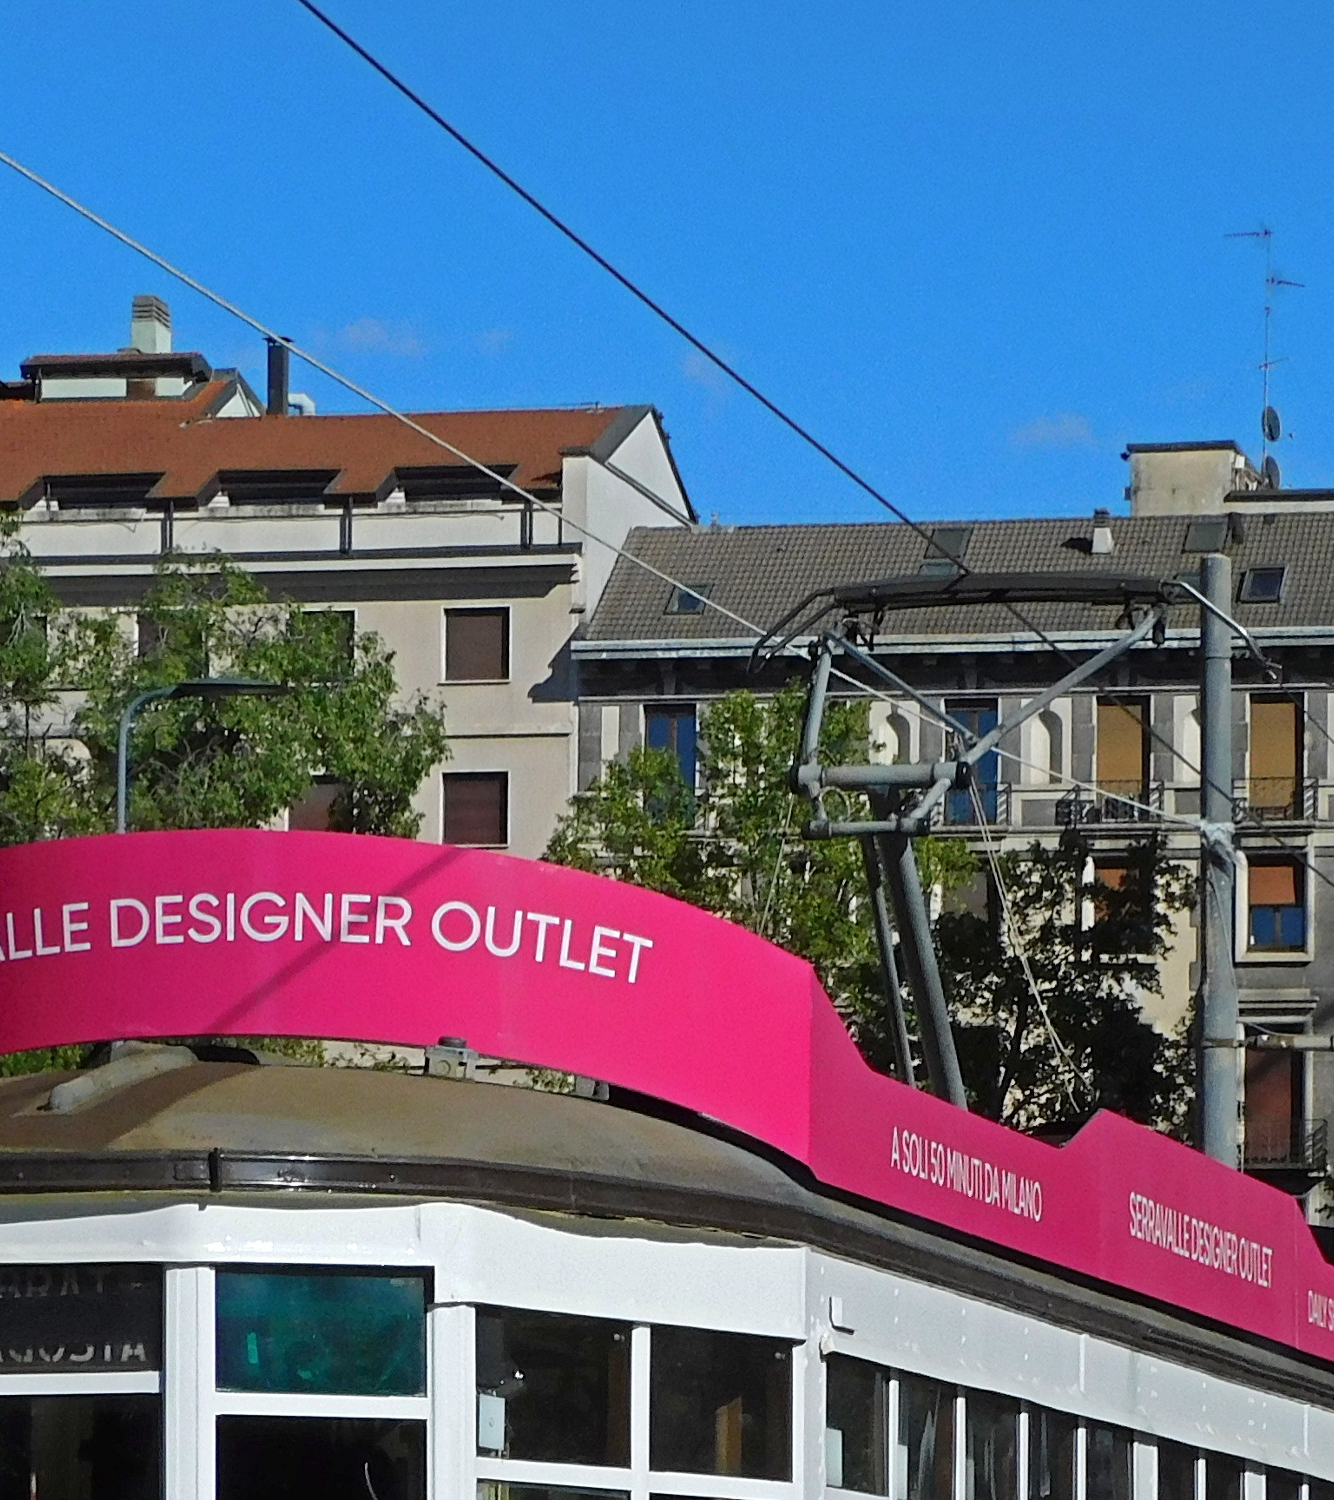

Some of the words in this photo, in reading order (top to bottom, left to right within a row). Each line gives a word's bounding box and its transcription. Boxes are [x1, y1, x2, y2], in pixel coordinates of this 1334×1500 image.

[110, 892, 413, 948] DESIGNER
[431, 901, 653, 984] OUTLET
[890, 1126, 901, 1170] A
[902, 1129, 929, 1180] SOLI
[930, 1141, 945, 1187] 50
[947, 1147, 983, 1201] MINUTI
[985, 1162, 1000, 1207] DA
[1001, 1169, 1042, 1222] MILANO
[1129, 1191, 1190, 1257] SERRAVALLE
[1191, 1217, 1238, 1276] DESIGNER
[1239, 1237, 1273, 1288] OUTLET
